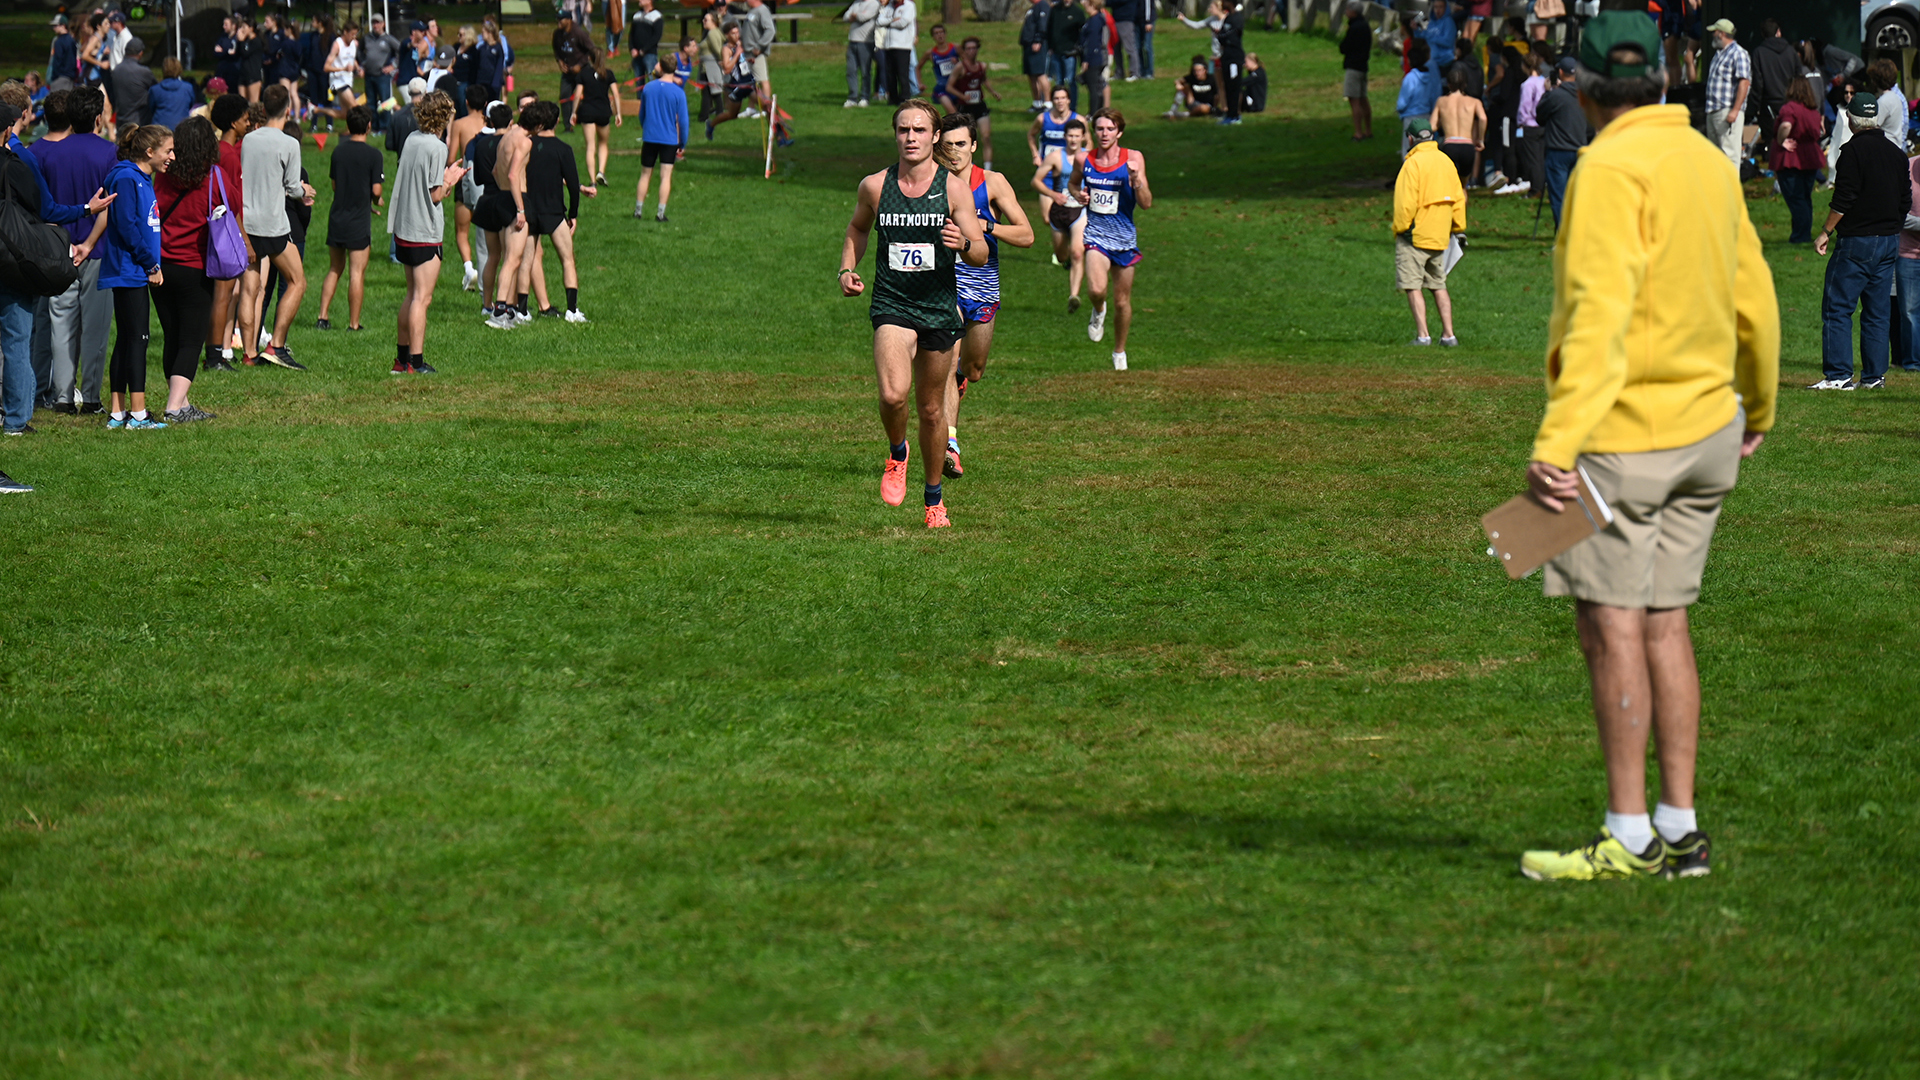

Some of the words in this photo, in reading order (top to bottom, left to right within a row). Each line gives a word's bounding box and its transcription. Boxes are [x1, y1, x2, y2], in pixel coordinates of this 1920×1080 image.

[1093, 192, 1114, 205] 304
[879, 213, 945, 227] DARTMOUTH
[900, 249, 923, 266] 76
